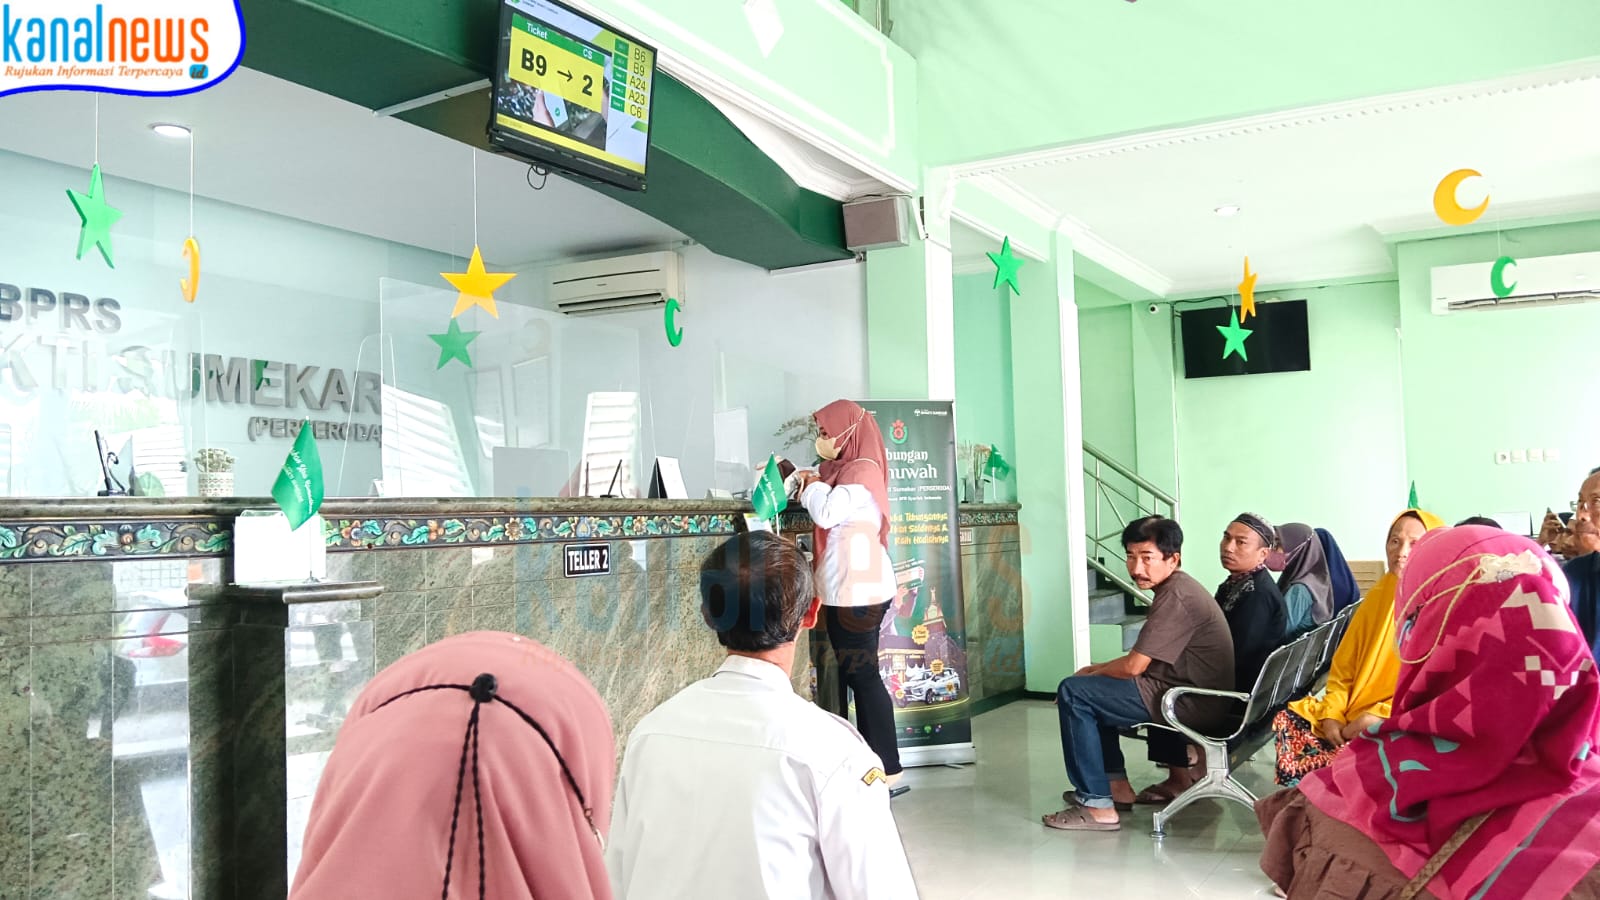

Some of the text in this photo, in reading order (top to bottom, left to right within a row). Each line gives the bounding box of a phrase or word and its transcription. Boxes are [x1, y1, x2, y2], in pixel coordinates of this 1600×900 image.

[527, 22, 593, 60] Ticket CS
[634, 47, 646, 63] B6
[521, 48, 593, 97] B9 2
[633, 62, 645, 77] B9
[629, 75, 647, 91] A24
[628, 89, 645, 106] A23
[630, 104, 642, 119] C6
[0, 283, 122, 334] BPRS
[568, 549, 609, 571] TELLER 2
